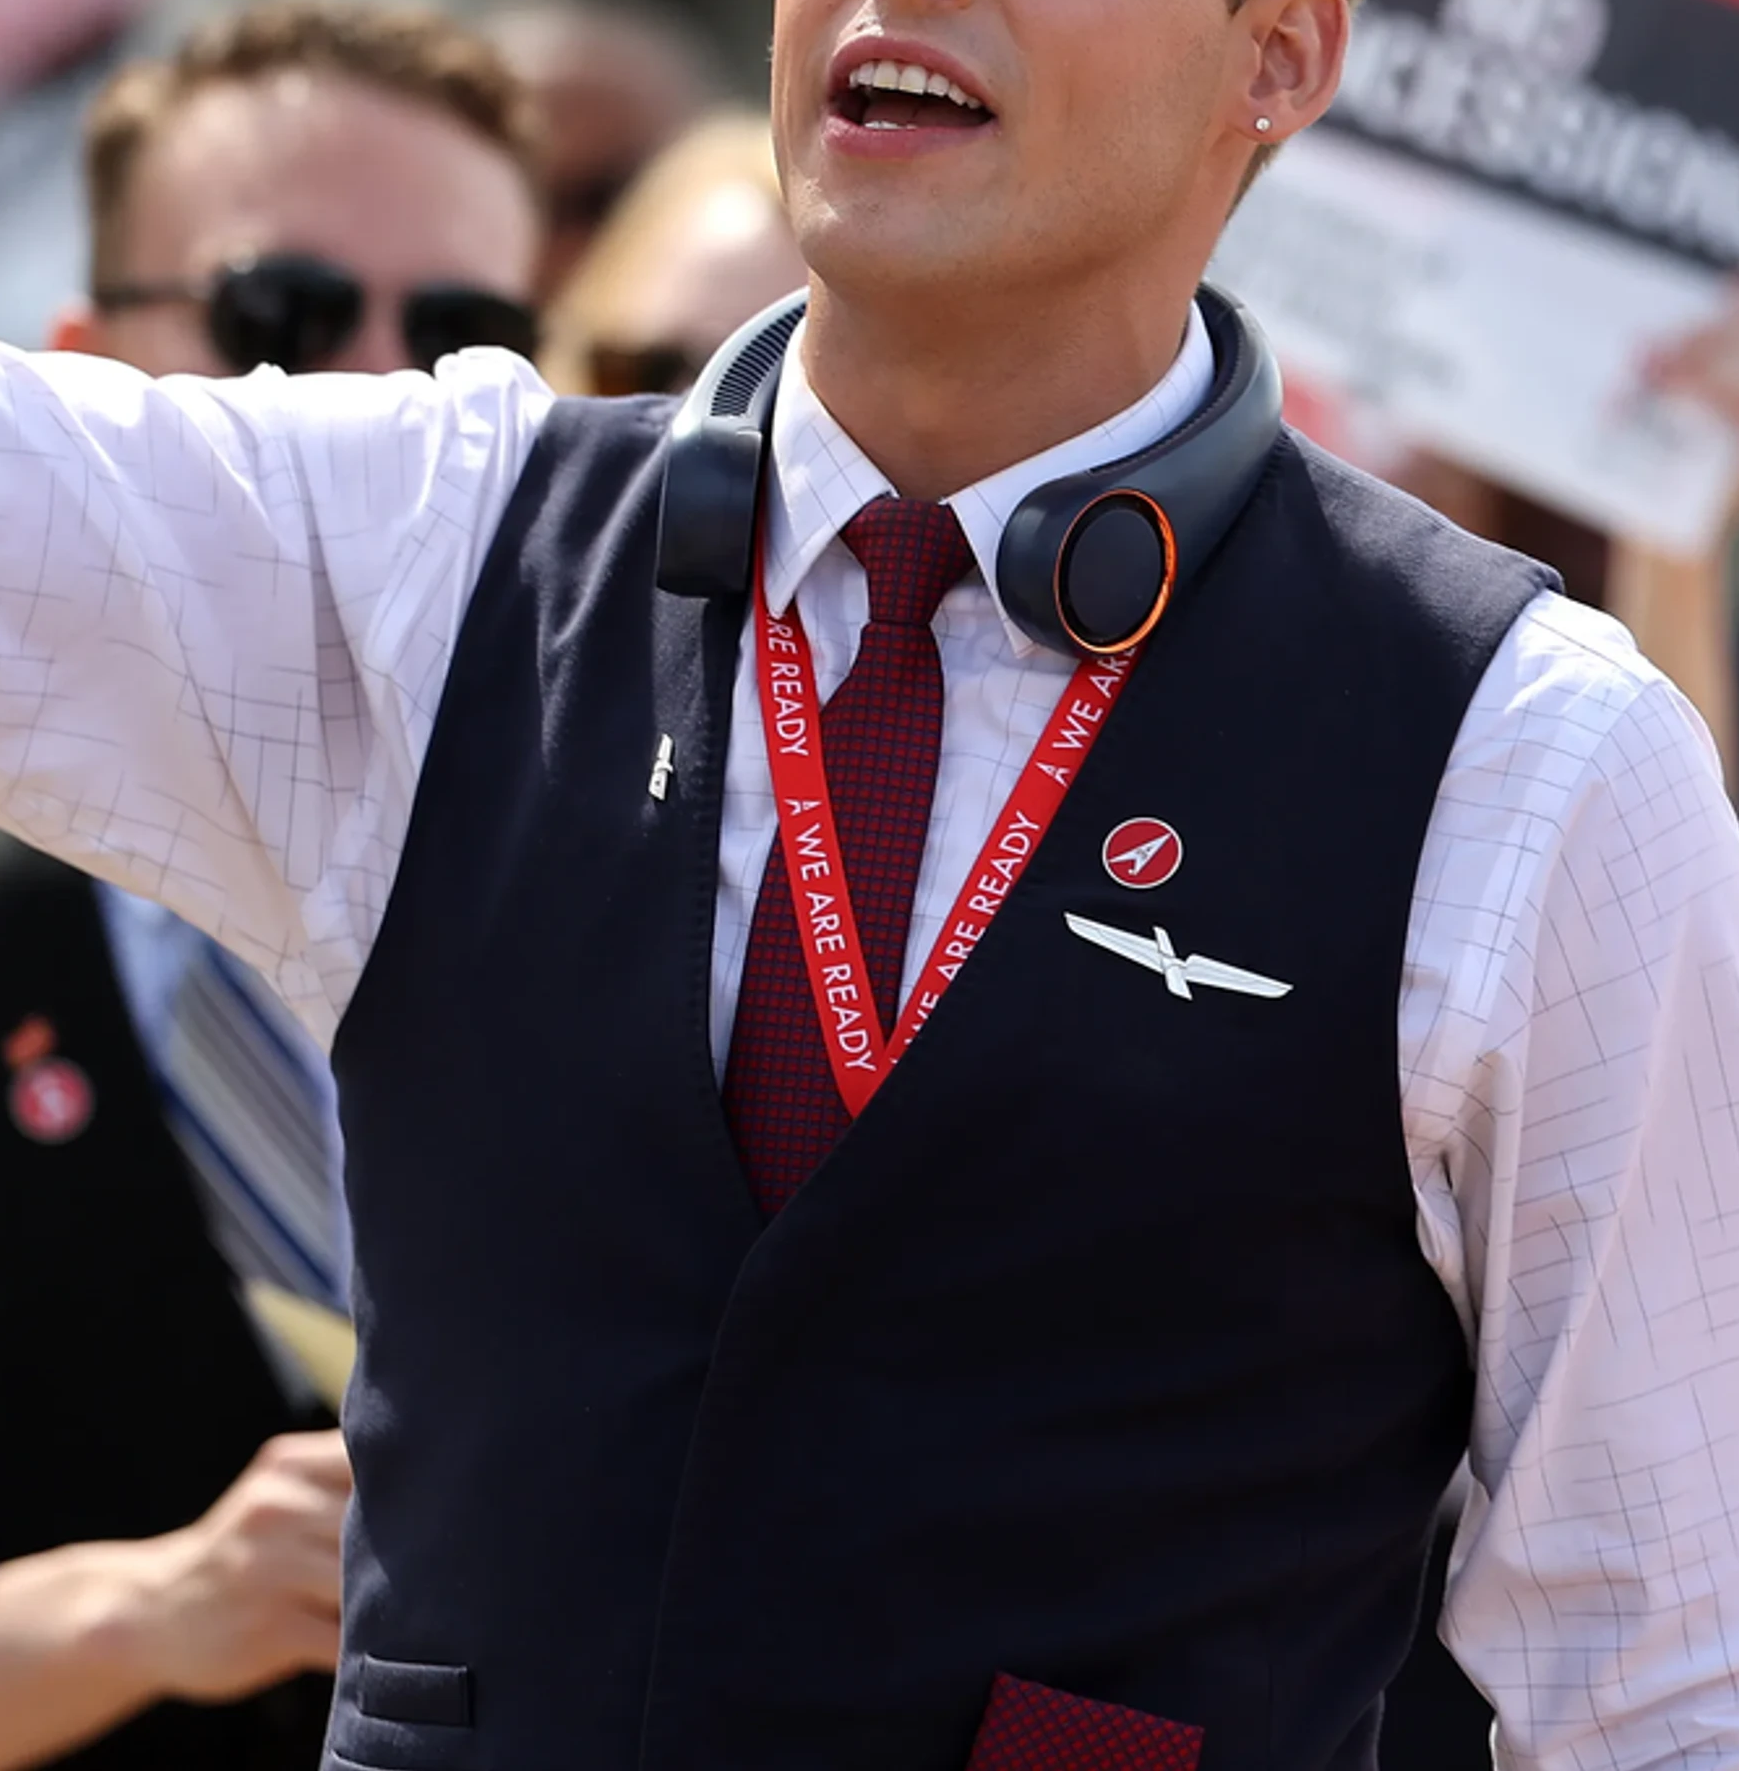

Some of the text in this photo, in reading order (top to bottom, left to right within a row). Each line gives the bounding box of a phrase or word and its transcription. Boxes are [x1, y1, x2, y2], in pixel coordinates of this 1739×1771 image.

[766, 612, 810, 757] RE READY
[1051, 699, 1104, 749] WE
[795, 823, 830, 881] WE
[936, 920, 987, 981] ARE
[967, 809, 1041, 916] READY
[805, 891, 846, 955] ARE
[822, 962, 877, 1072] READY
